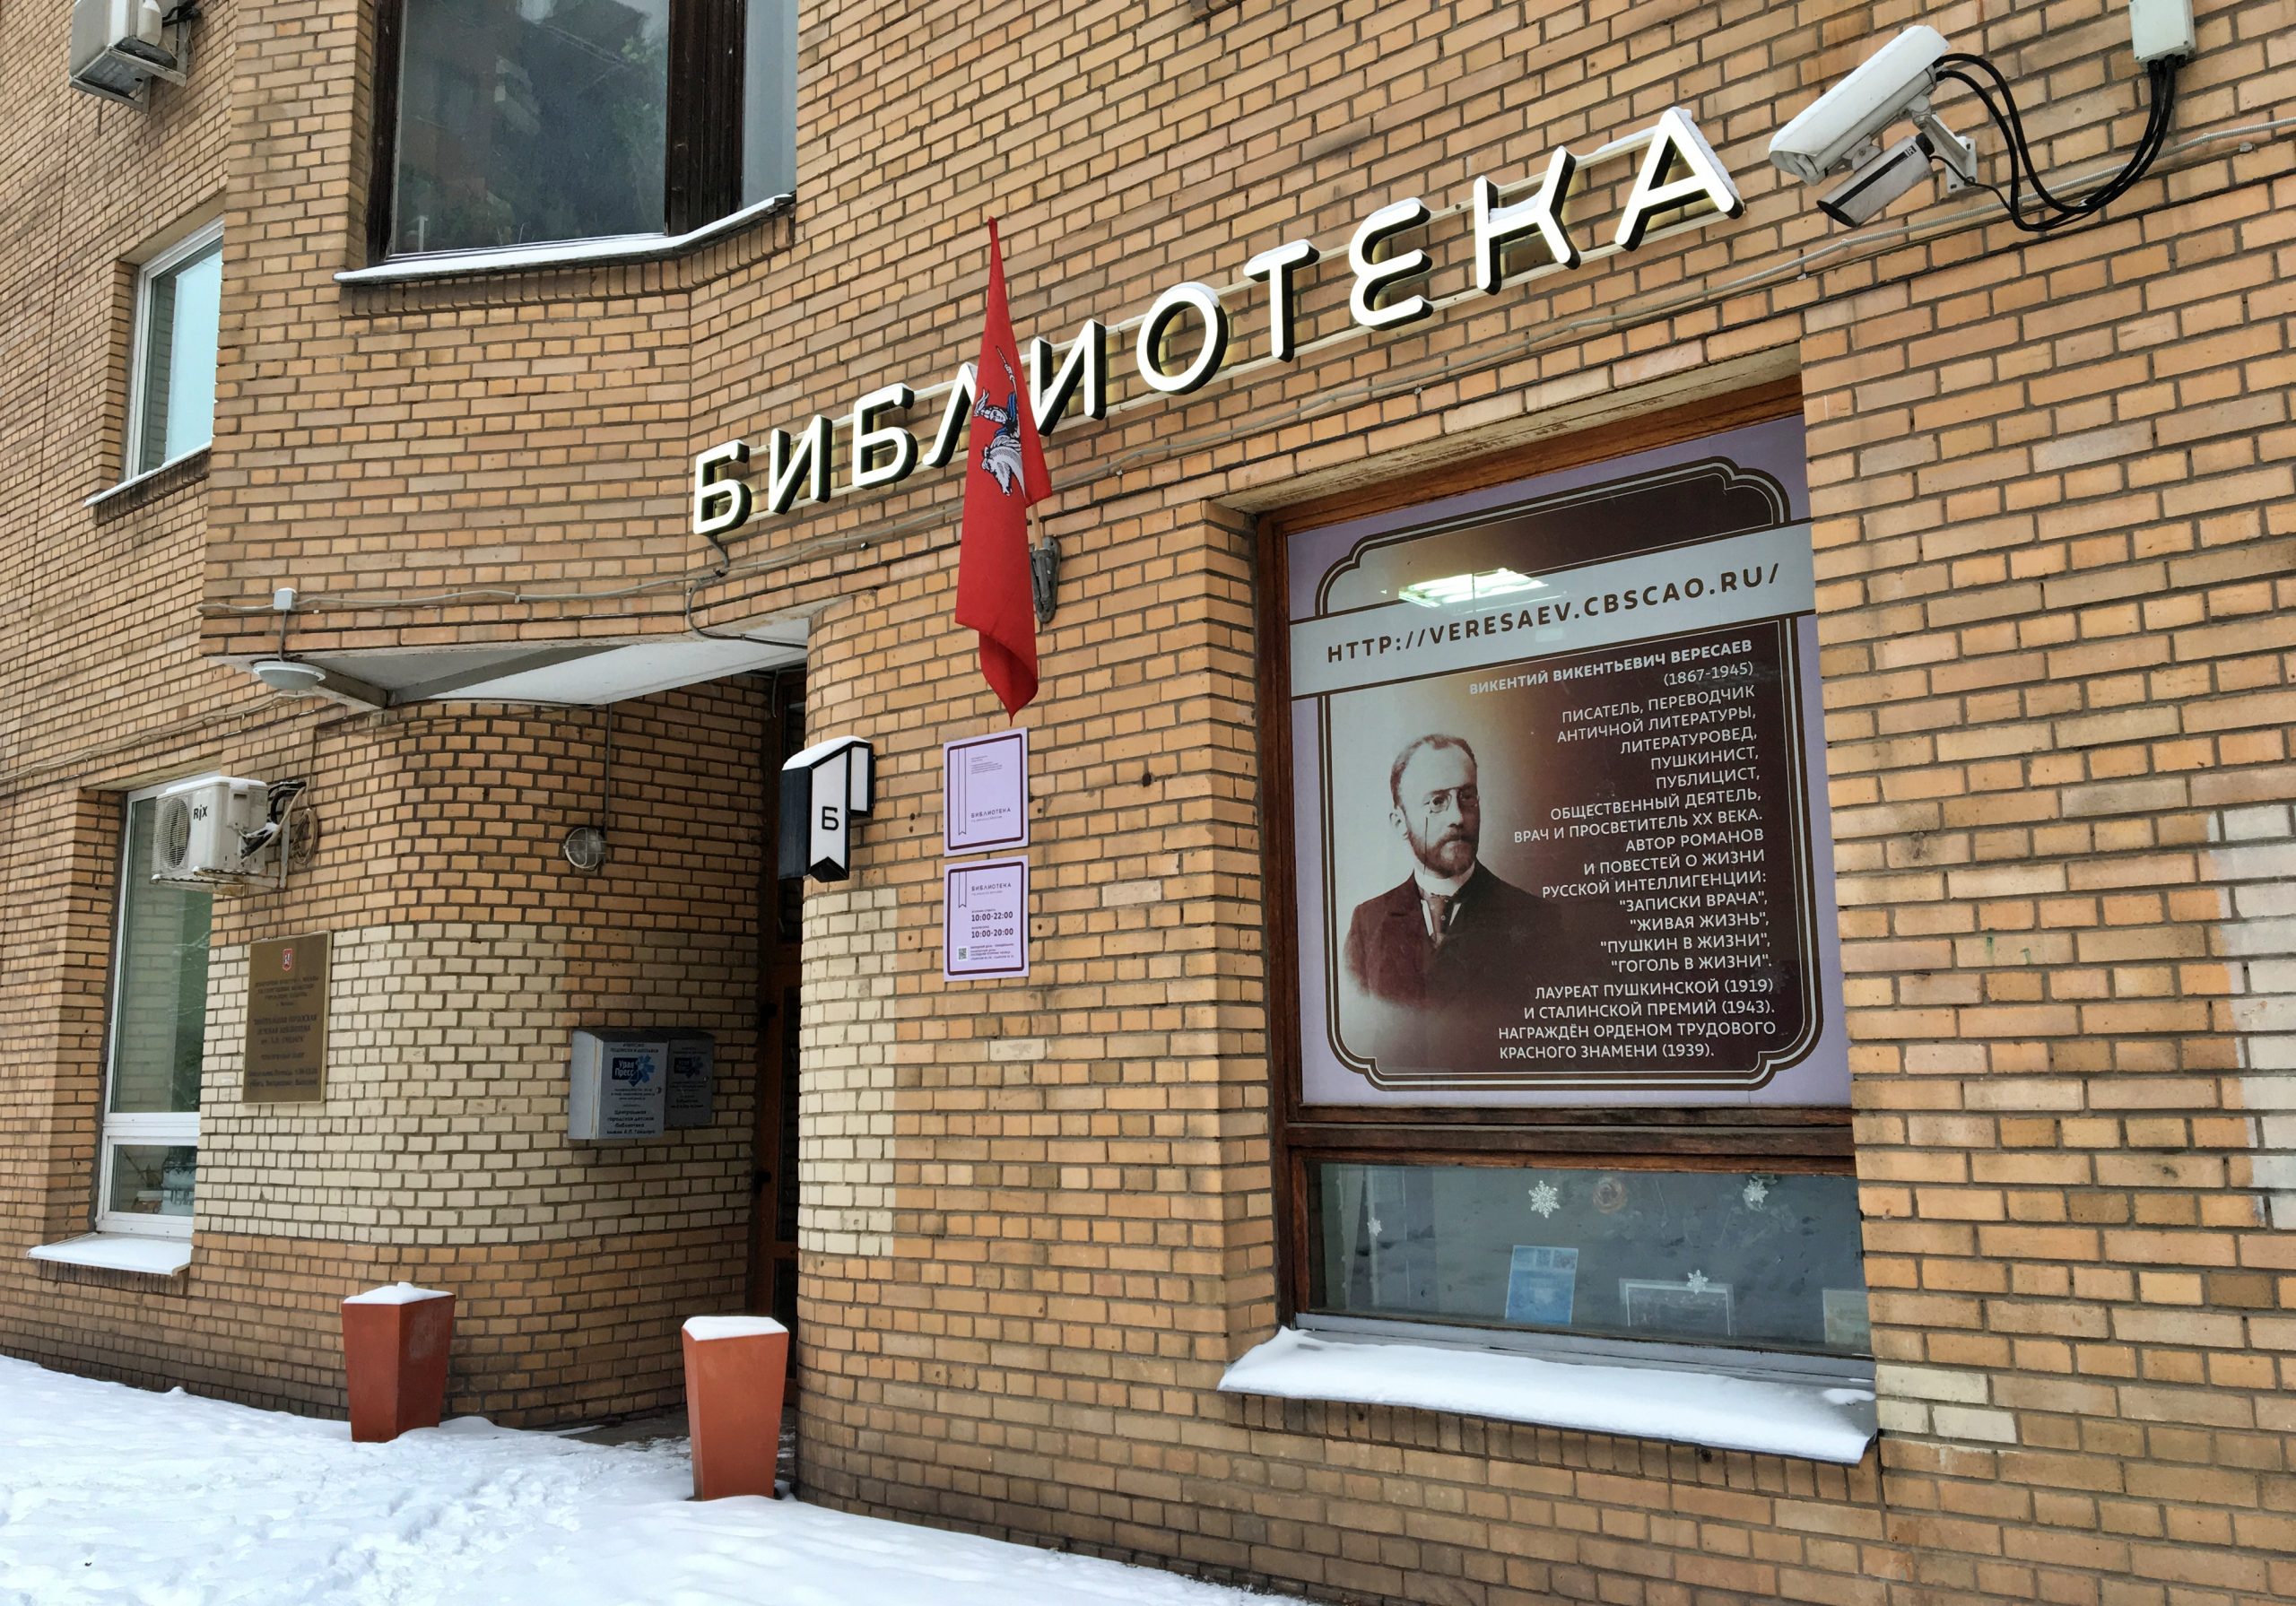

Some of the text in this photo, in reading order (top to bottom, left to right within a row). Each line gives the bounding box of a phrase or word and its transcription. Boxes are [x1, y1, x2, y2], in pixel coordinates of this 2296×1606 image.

[693, 107, 1744, 536] БИБЛИОТЕКА
[1328, 563, 1779, 664] HTTP://VERESAEV.CBSCAO.RU/
[1470, 640, 1752, 695] ВИКЕНТИЙ ВИКЕНТЬЕВИЧ ВЕРЕСАЕВ
[1664, 662, 1752, 687] (1867-1945)
[1562, 685, 1754, 724] ПИСАТЕЛЬ, ПЕРЕВОДЧИК
[1557, 706, 1756, 743] АНТИЧНОЙ ЛИТЕРАТУРЫ,
[1621, 726, 1757, 755] ЛИТЕРАТУРОВЕД,
[1651, 747, 1758, 769] ПУШКИНИСТ,
[1656, 767, 1760, 789] ПУБЛИЦИСТ,
[970, 807, 1012, 819] БИБЛИОТЕКА
[1551, 788, 1761, 821] ОБЩЕСТВЕННЫЙ ДЕЯТЕЛЬ,
[822, 805, 839, 830] Б
[1515, 829, 1550, 843] ВРАЧ
[1554, 827, 1564, 839] И
[1570, 816, 1688, 838] ПРОСВЕТИТЕЛЬ
[1718, 809, 1761, 823] ВЕКА.
[1626, 829, 1763, 853] АВТОР РОМАНОВ
[1585, 849, 1764, 874] И ПОВЕСТЕЙ О ЖИЗНИ
[970, 882, 1012, 892] БИБЛИОТЕКА
[1543, 871, 1766, 898] РУССКОЙ ИНТЕЛЛИГЕНЦИИ:
[1620, 891, 1768, 912] "ЗАПИСКИ ВРАЧА",
[970, 911, 1013, 922] 10:00-22:00
[1631, 912, 1769, 932] "ЖИВАЯ ЖИЗНЬ",
[970, 928, 1014, 939] 10:00-20:00
[1601, 933, 1770, 953] "ПУШКИН В ЖИЗНИ",
[1612, 953, 1771, 973] "ГОГОЛЬ В ЖИЗНИ".
[1535, 977, 1773, 1000] ЛАУРЕАТ ПУШКИНСКОЙ (1919)
[1525, 999, 1774, 1020] И СТАЛИНСКОЙ ПРЕМИЙ (1943).
[1499, 1022, 1776, 1041] НАГРАЖДЁН ОРДЕНОМ ТРУДОВОГО
[1500, 1044, 1714, 1059] КРАСНОГО ЗНАМЕНИ (1939).
[614, 1068, 634, 1078] Пресс
[618, 1059, 634, 1069] Урал
